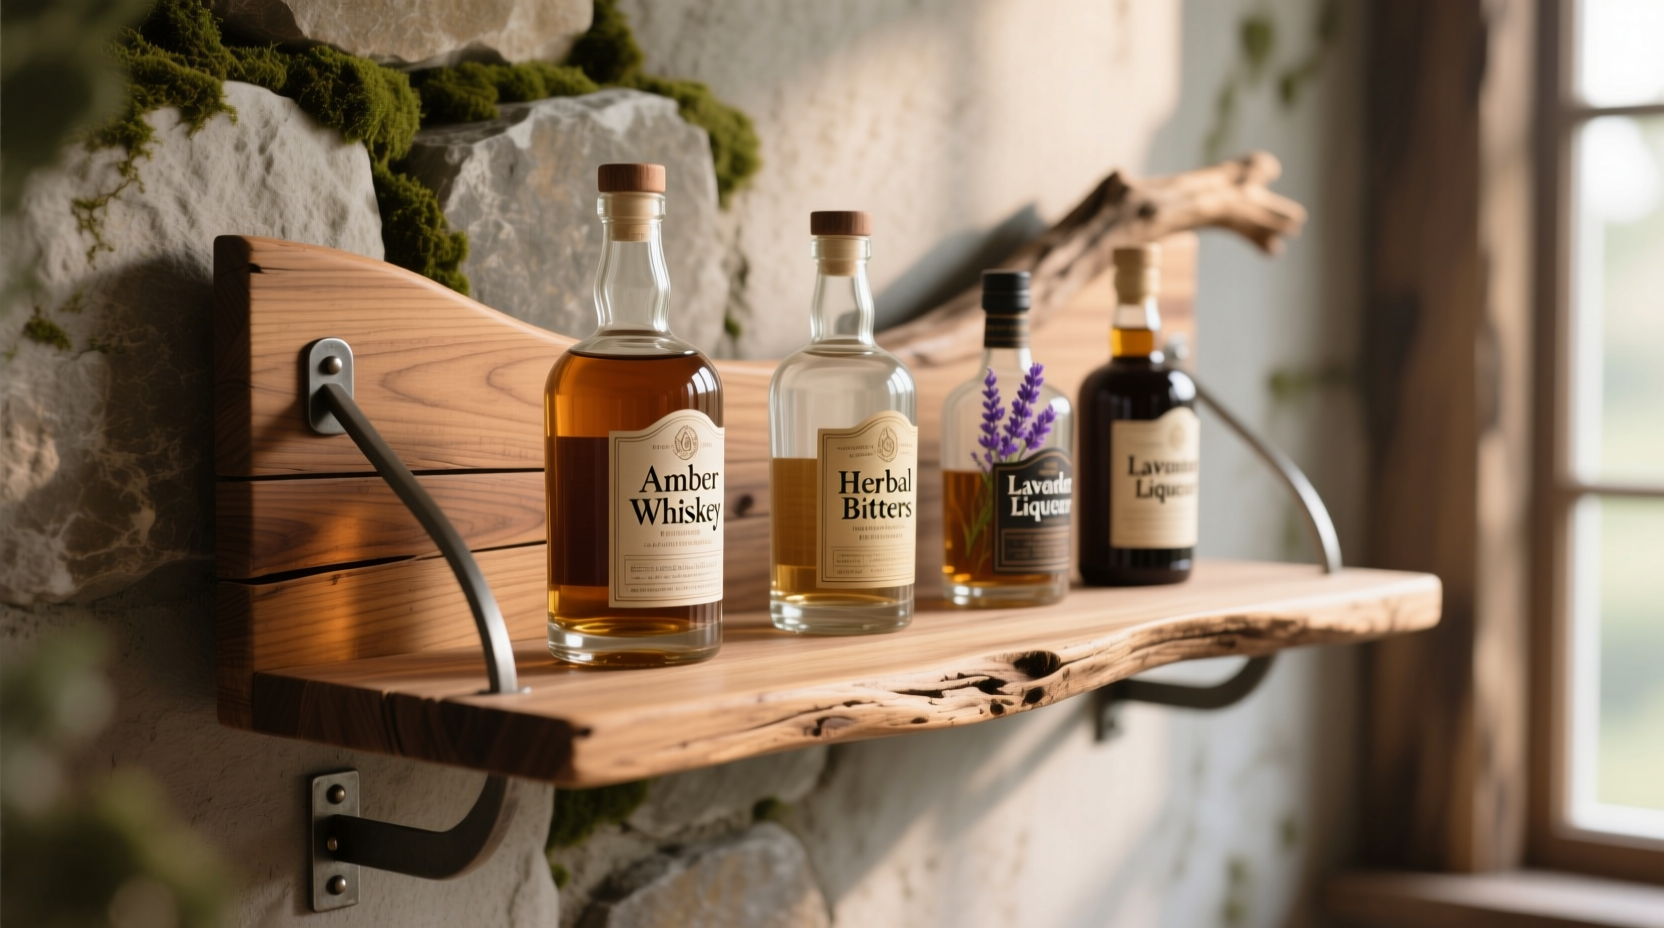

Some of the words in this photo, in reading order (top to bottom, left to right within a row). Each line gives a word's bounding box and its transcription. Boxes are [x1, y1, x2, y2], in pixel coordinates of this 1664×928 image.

[639, 464, 719, 493] Amber
[838, 468, 912, 494] Herbal
[629, 496, 721, 531] Whiskey
[841, 497, 912, 520] Bitters
